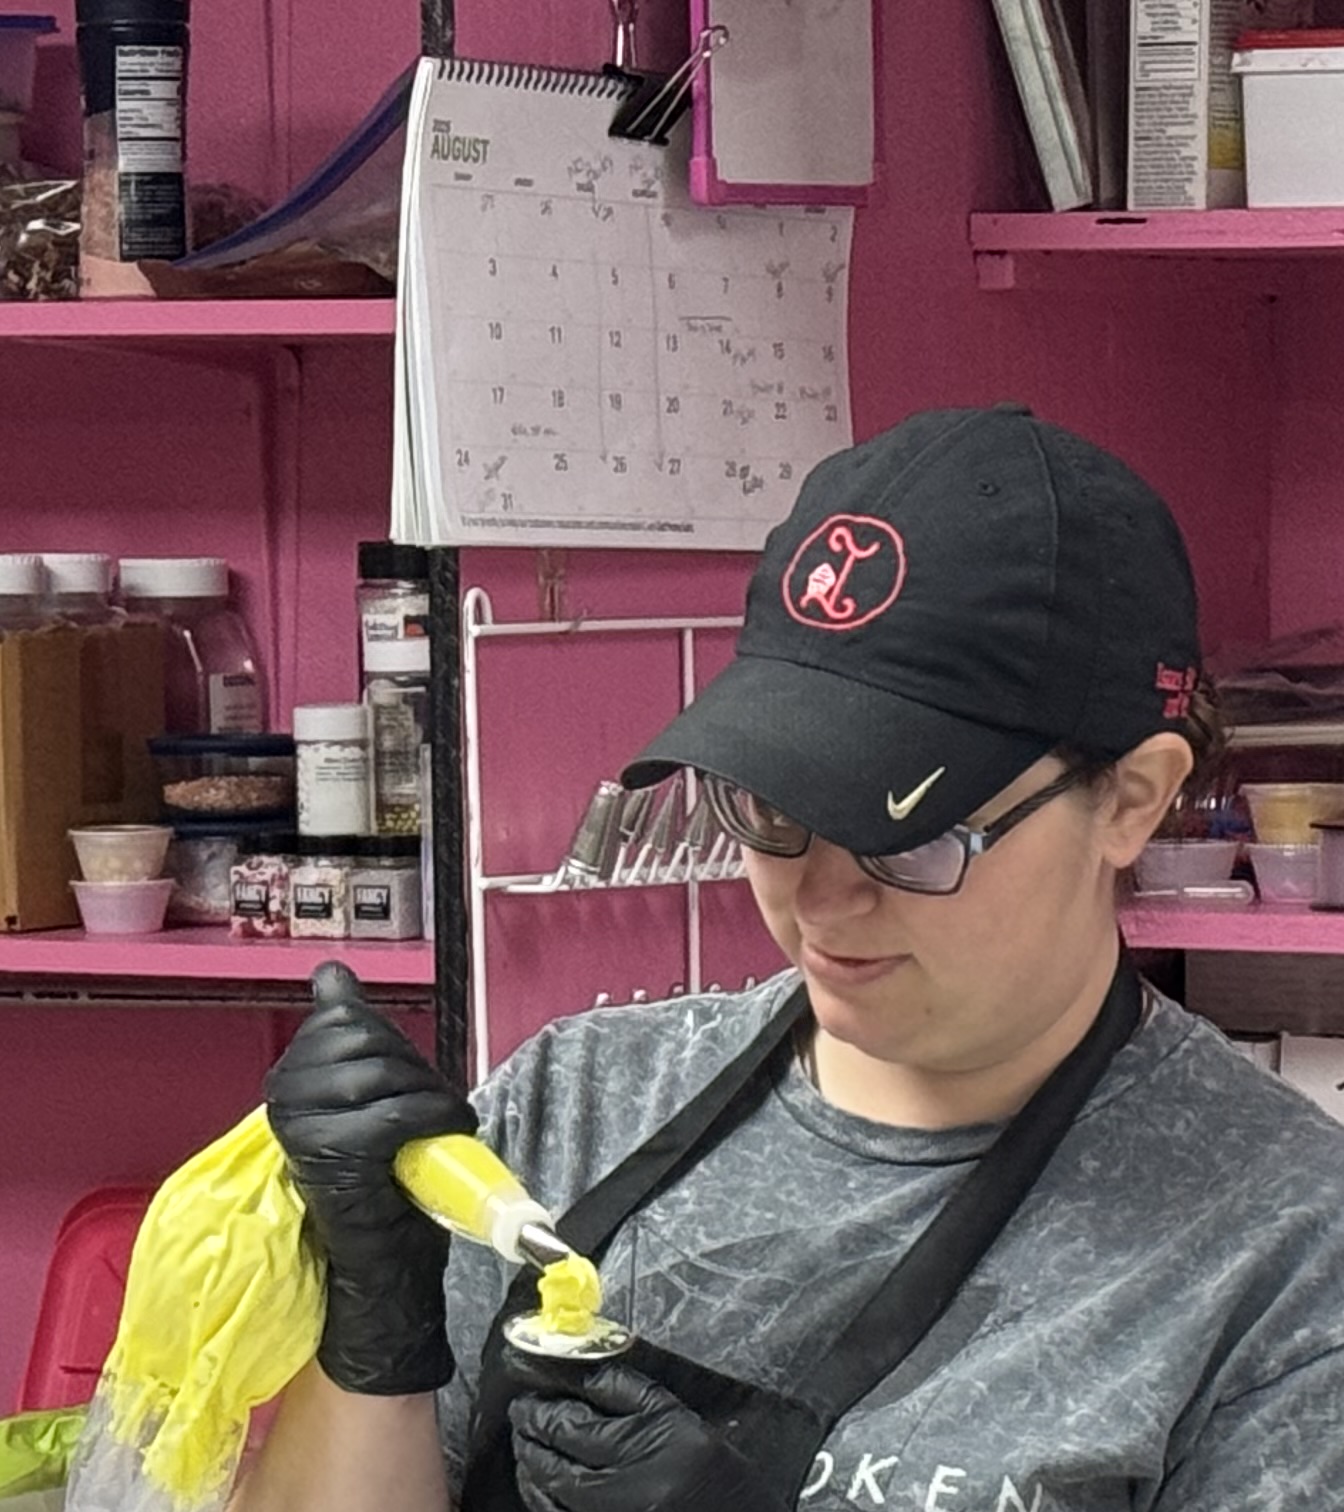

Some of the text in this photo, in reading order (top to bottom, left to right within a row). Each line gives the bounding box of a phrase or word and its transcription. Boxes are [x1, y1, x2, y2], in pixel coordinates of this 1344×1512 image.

[431, 134, 491, 164] AUGUST
[488, 258, 497, 276] 3
[611, 268, 619, 286] 5
[668, 272, 676, 290] 6
[722, 276, 729, 294] 7
[488, 322, 503, 340] 10
[549, 325, 562, 344] 11
[608, 330, 622, 349] 12
[665, 333, 678, 353] 13
[492, 387, 504, 404] 17
[552, 390, 565, 408] 18
[608, 393, 623, 411] 19
[665, 396, 680, 414] 20
[774, 402, 787, 420] 22
[456, 449, 470, 467] 24
[553, 453, 569, 471] 25
[612, 456, 627, 473] 26
